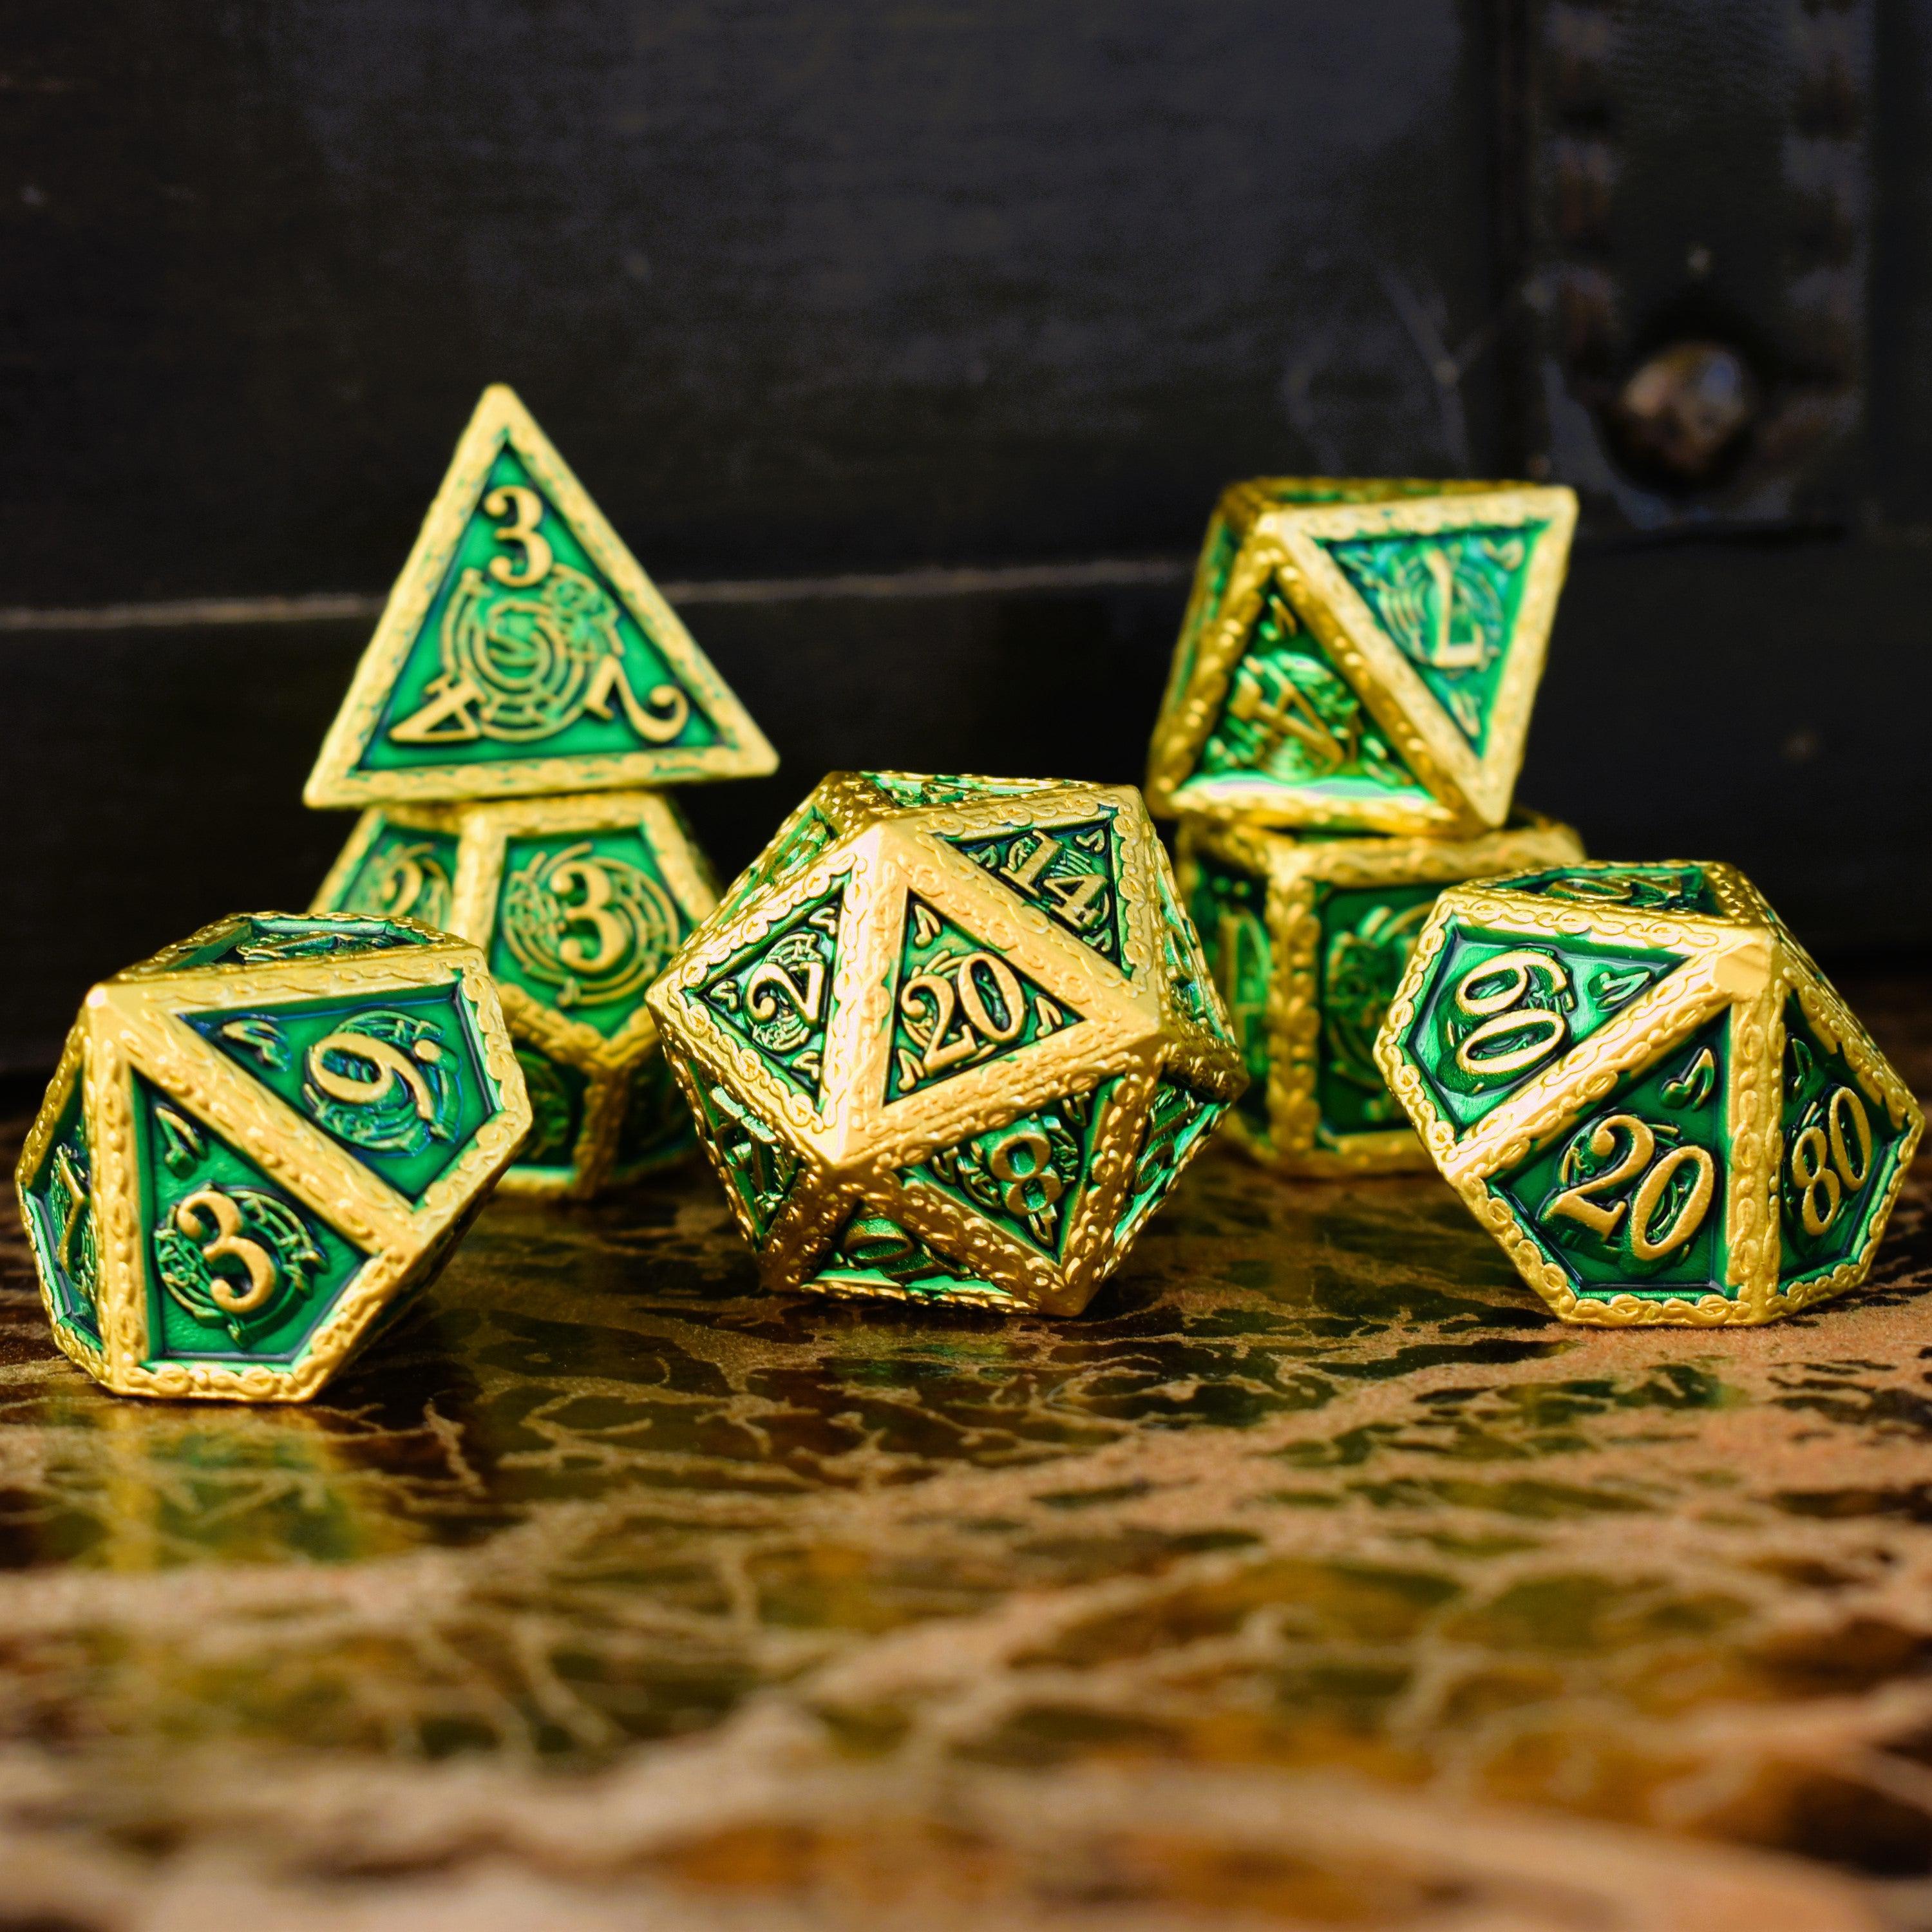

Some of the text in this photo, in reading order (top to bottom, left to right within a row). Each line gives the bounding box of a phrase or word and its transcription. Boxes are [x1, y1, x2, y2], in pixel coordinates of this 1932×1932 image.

[484, 485, 553, 587] 3
[549, 858, 627, 971] 3
[999, 828, 1109, 931] 14
[902, 952, 1027, 1078] 20
[989, 1128, 1063, 1217] 8
[1544, 1114, 1717, 1262] 20
[1792, 1086, 1872, 1236] 80
[177, 1190, 277, 1314] 3
